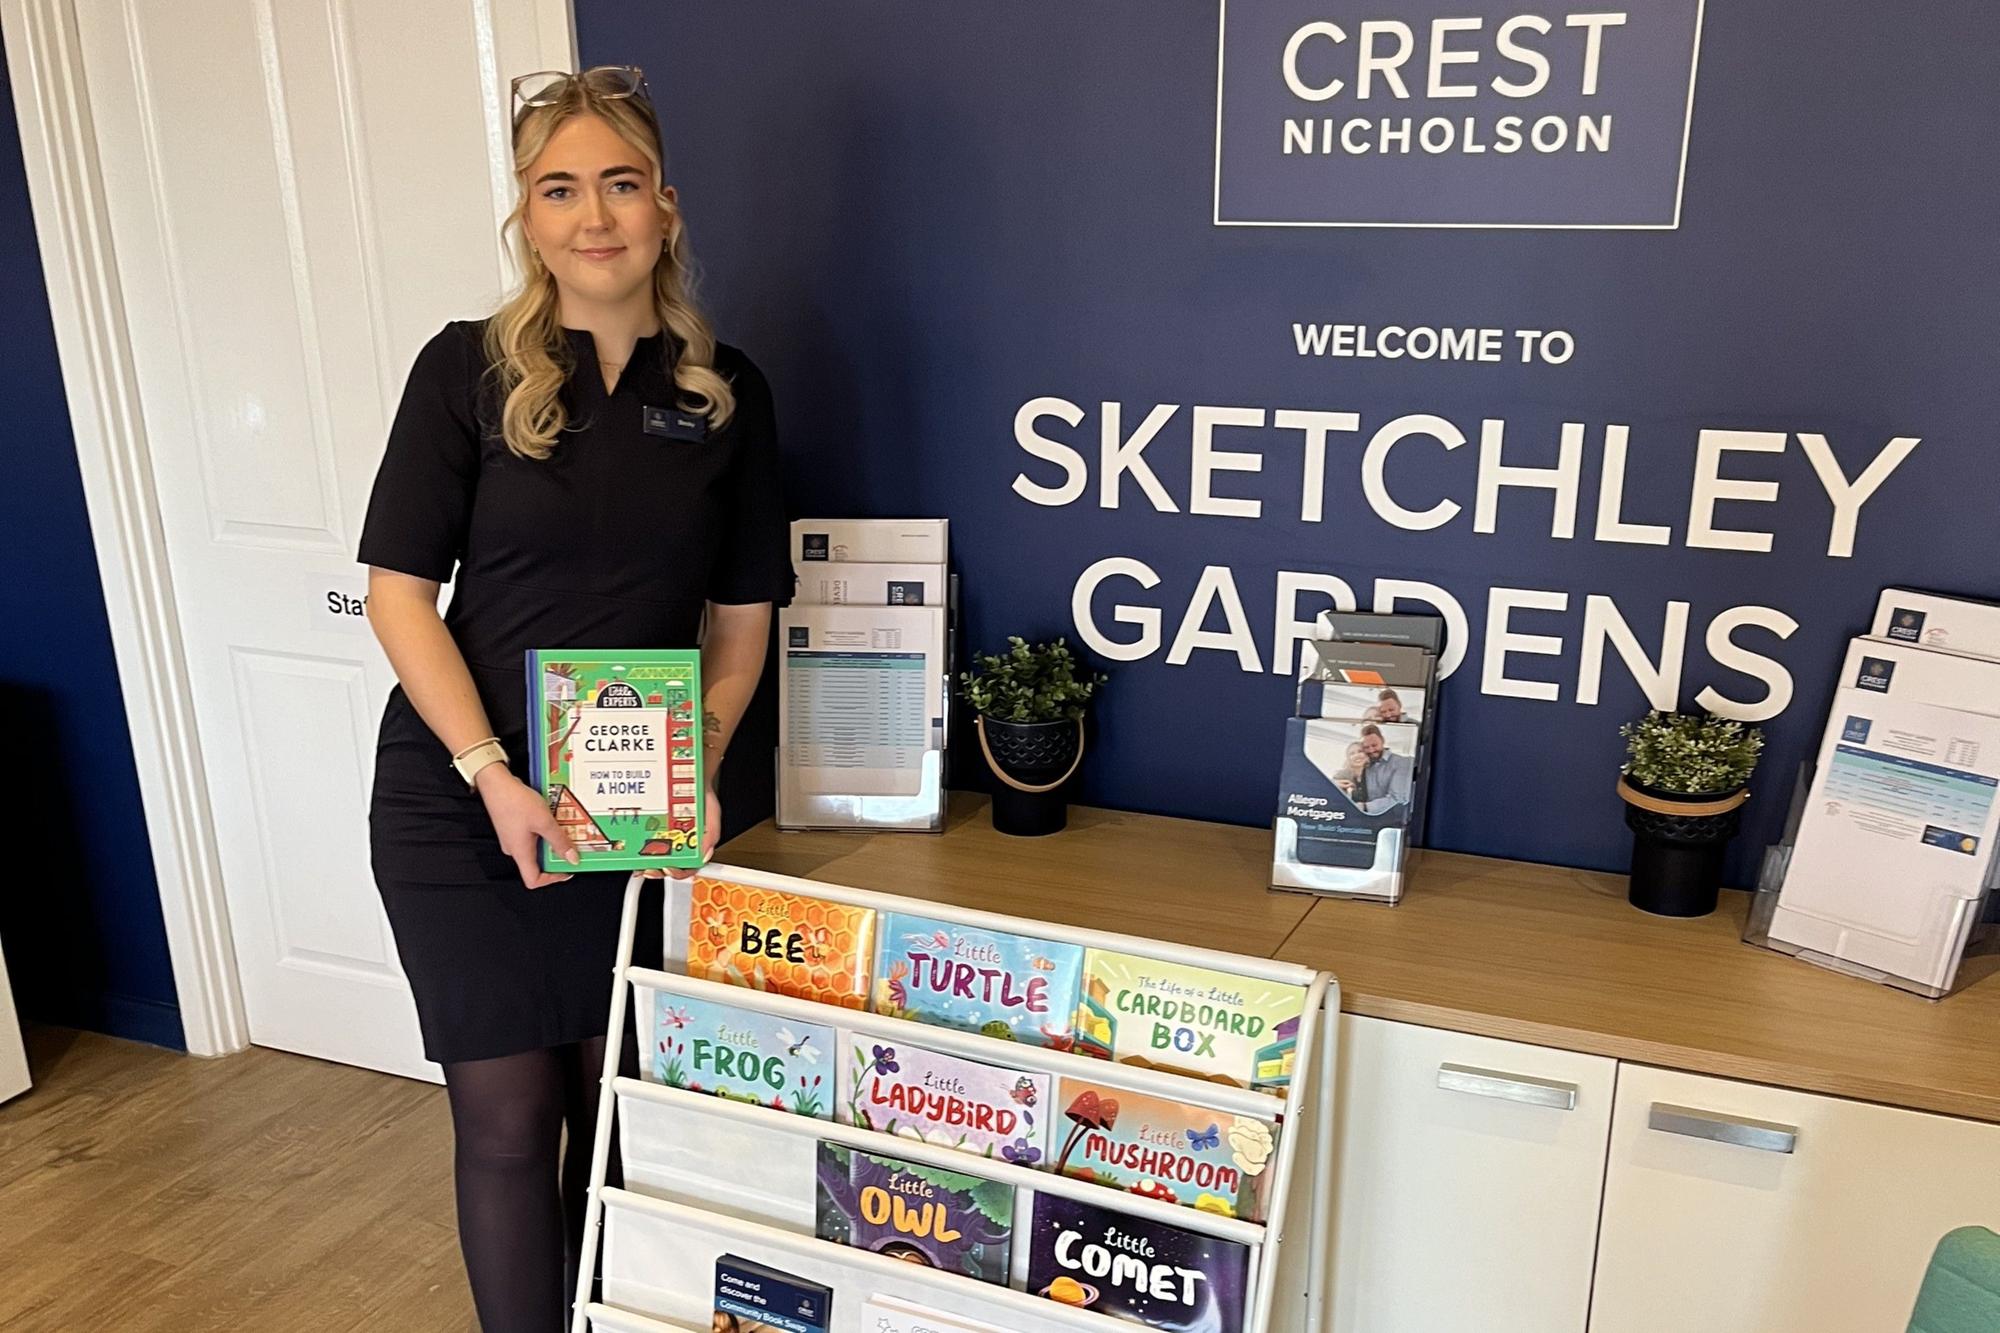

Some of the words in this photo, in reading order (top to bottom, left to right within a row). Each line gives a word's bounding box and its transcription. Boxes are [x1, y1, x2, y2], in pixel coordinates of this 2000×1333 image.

[1281, 11, 1627, 102] CREST
[1282, 114, 1612, 155] NICHOLSON
[1293, 323, 1503, 363] WELCOME
[1515, 329, 1575, 364] TO
[1011, 396, 1921, 559] SKETCHLEY
[589, 725, 650, 736] GEORGE
[585, 738, 655, 752] CLARKE
[590, 771, 610, 779] HOW
[612, 771, 624, 779] TO
[625, 770, 652, 779] BUILD
[596, 782, 606, 794] A
[609, 781, 646, 794] HOME
[1286, 806, 1346, 821] Mortgages
[1288, 793, 1328, 807] Allegro
[757, 901, 790, 919] Little
[740, 921, 806, 963] BEE
[953, 937, 1002, 965] Little
[907, 952, 1049, 1013] TURTLE
[1138, 976, 1157, 989] The
[1159, 979, 1182, 995] Life
[1184, 987, 1196, 997] of
[1208, 986, 1245, 1006] Little
[1116, 989, 1265, 1039] CARDBOARD
[717, 1025, 759, 1049] Little
[1150, 1022, 1217, 1059] BOX
[692, 1039, 786, 1090] FROG
[923, 1070, 966, 1096] Little
[1139, 1124, 1185, 1151] Little
[1085, 1133, 1239, 1194] MUSHROOM
[887, 1173, 934, 1199] Little
[859, 1185, 963, 1244] OWL
[1103, 1226, 1156, 1259] Little
[1053, 1229, 1207, 1307] COMET
[720, 1273, 744, 1287] Come
[744, 1281, 761, 1292] and
[720, 1285, 753, 1301] discover
[753, 1295, 768, 1306] the
[719, 1299, 762, 1321] Community
[762, 1312, 784, 1326] Book
